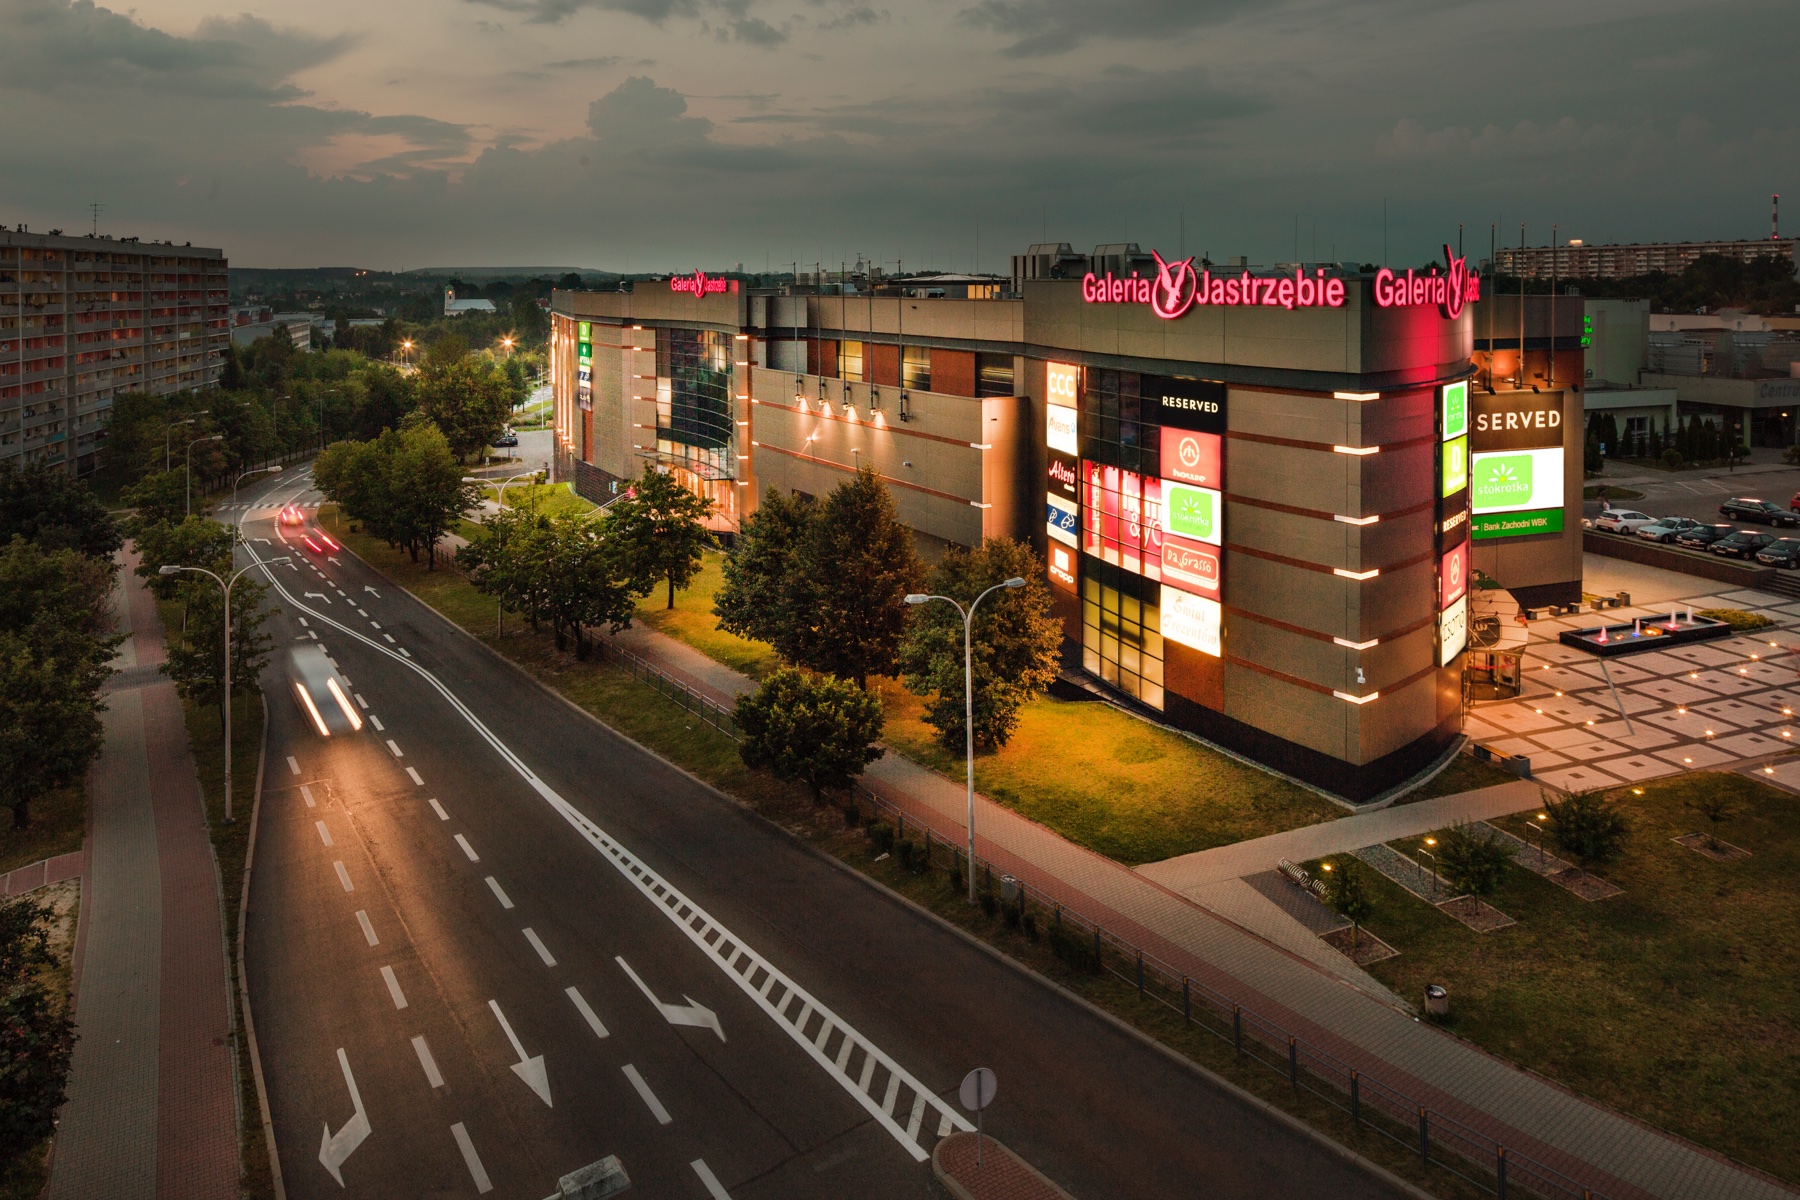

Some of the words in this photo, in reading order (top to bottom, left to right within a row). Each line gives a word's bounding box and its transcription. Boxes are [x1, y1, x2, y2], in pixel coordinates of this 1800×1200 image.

[671, 276, 695, 292] Galeria
[1083, 270, 1150, 303] Galeria
[1196, 268, 1345, 309] Jastrzębie
[1375, 267, 1445, 307] Galeria
[1048, 372, 1075, 397] CCC
[1162, 395, 1219, 414] RESERVED
[1048, 416, 1071, 435] Avans
[1477, 481, 1529, 495] stokrotka
[1173, 511, 1209, 527] stokrotka
[1443, 510, 1467, 533] RESERVED
[1483, 522, 1500, 531] Bank
[1501, 519, 1531, 530] Zachodni
[1531, 517, 1548, 527] WBK
[1050, 565, 1074, 584] cropp
[1173, 596, 1205, 622] Świat
